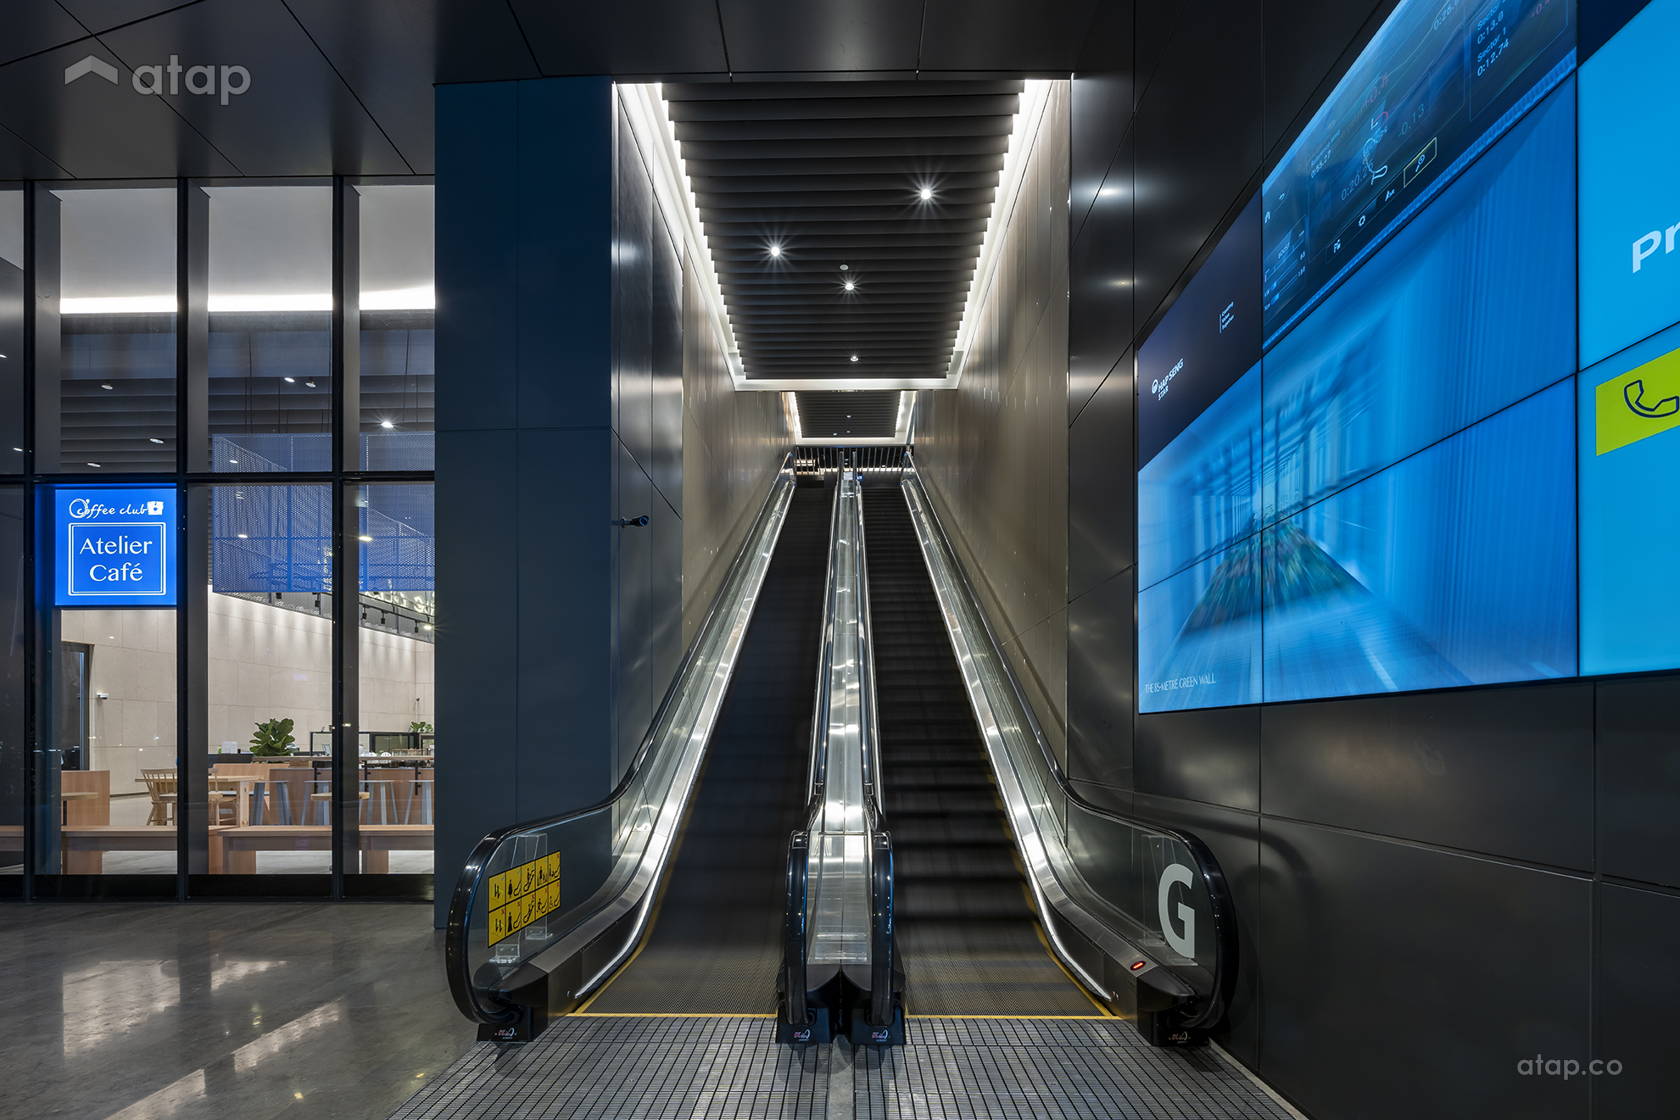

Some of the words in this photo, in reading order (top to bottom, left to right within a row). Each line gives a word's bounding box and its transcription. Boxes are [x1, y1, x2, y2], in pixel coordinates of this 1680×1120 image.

[1168, 358, 1184, 380] SENG
[80, 535, 153, 555] Atelier
[90, 562, 144, 582] Café
[1179, 675, 1199, 689] GREEN
[1199, 672, 1217, 685] WALL
[1158, 863, 1195, 959] G
